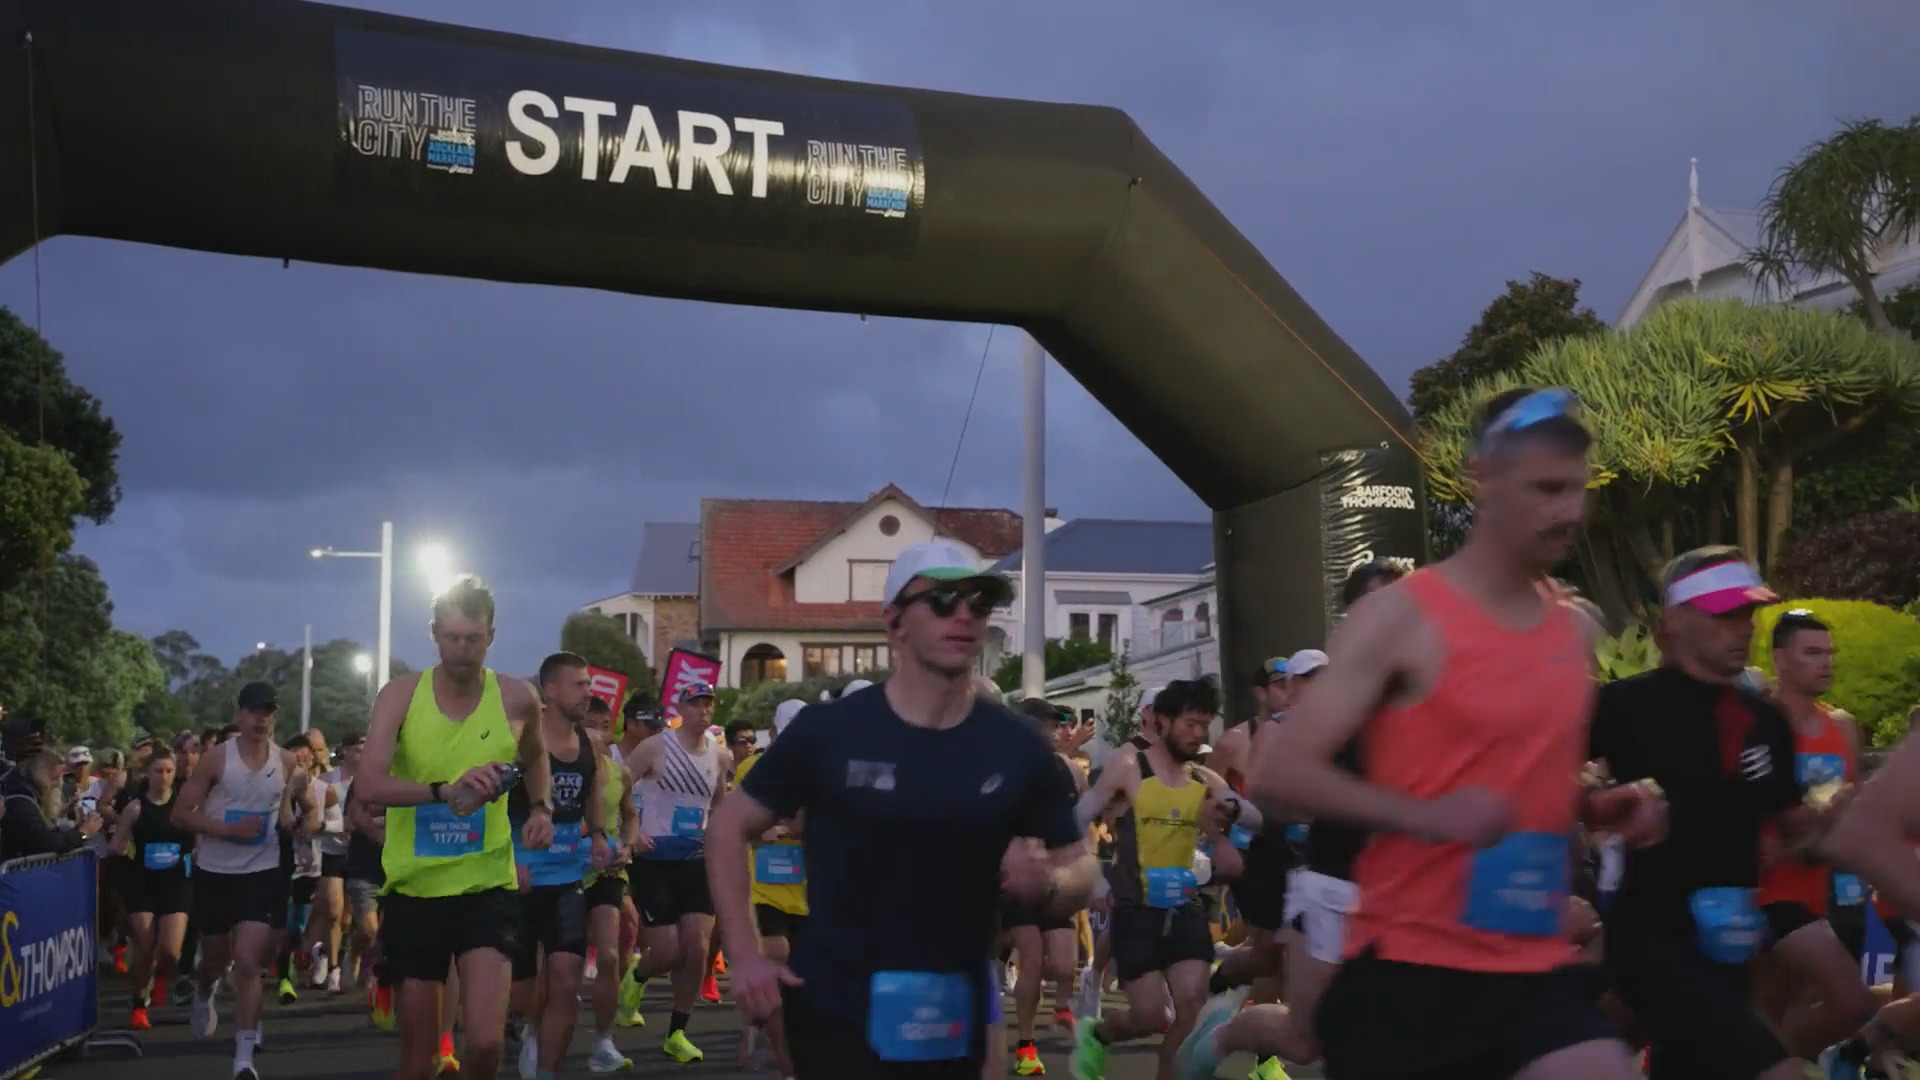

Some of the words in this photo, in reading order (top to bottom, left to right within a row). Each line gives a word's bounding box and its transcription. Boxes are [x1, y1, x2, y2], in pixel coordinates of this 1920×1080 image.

[358, 84, 417, 126] RUN
[420, 92, 476, 133] THE
[358, 119, 428, 160] CITY
[505, 89, 784, 198] START
[807, 140, 858, 171] RUN
[860, 145, 907, 172] THE
[428, 150, 475, 167] MARATHON
[807, 174, 865, 207] CITY
[1340, 495, 1405, 508] THOMPSON
[1355, 485, 1405, 498] BARFOOT
[20, 922, 95, 1002] THOMPSON
